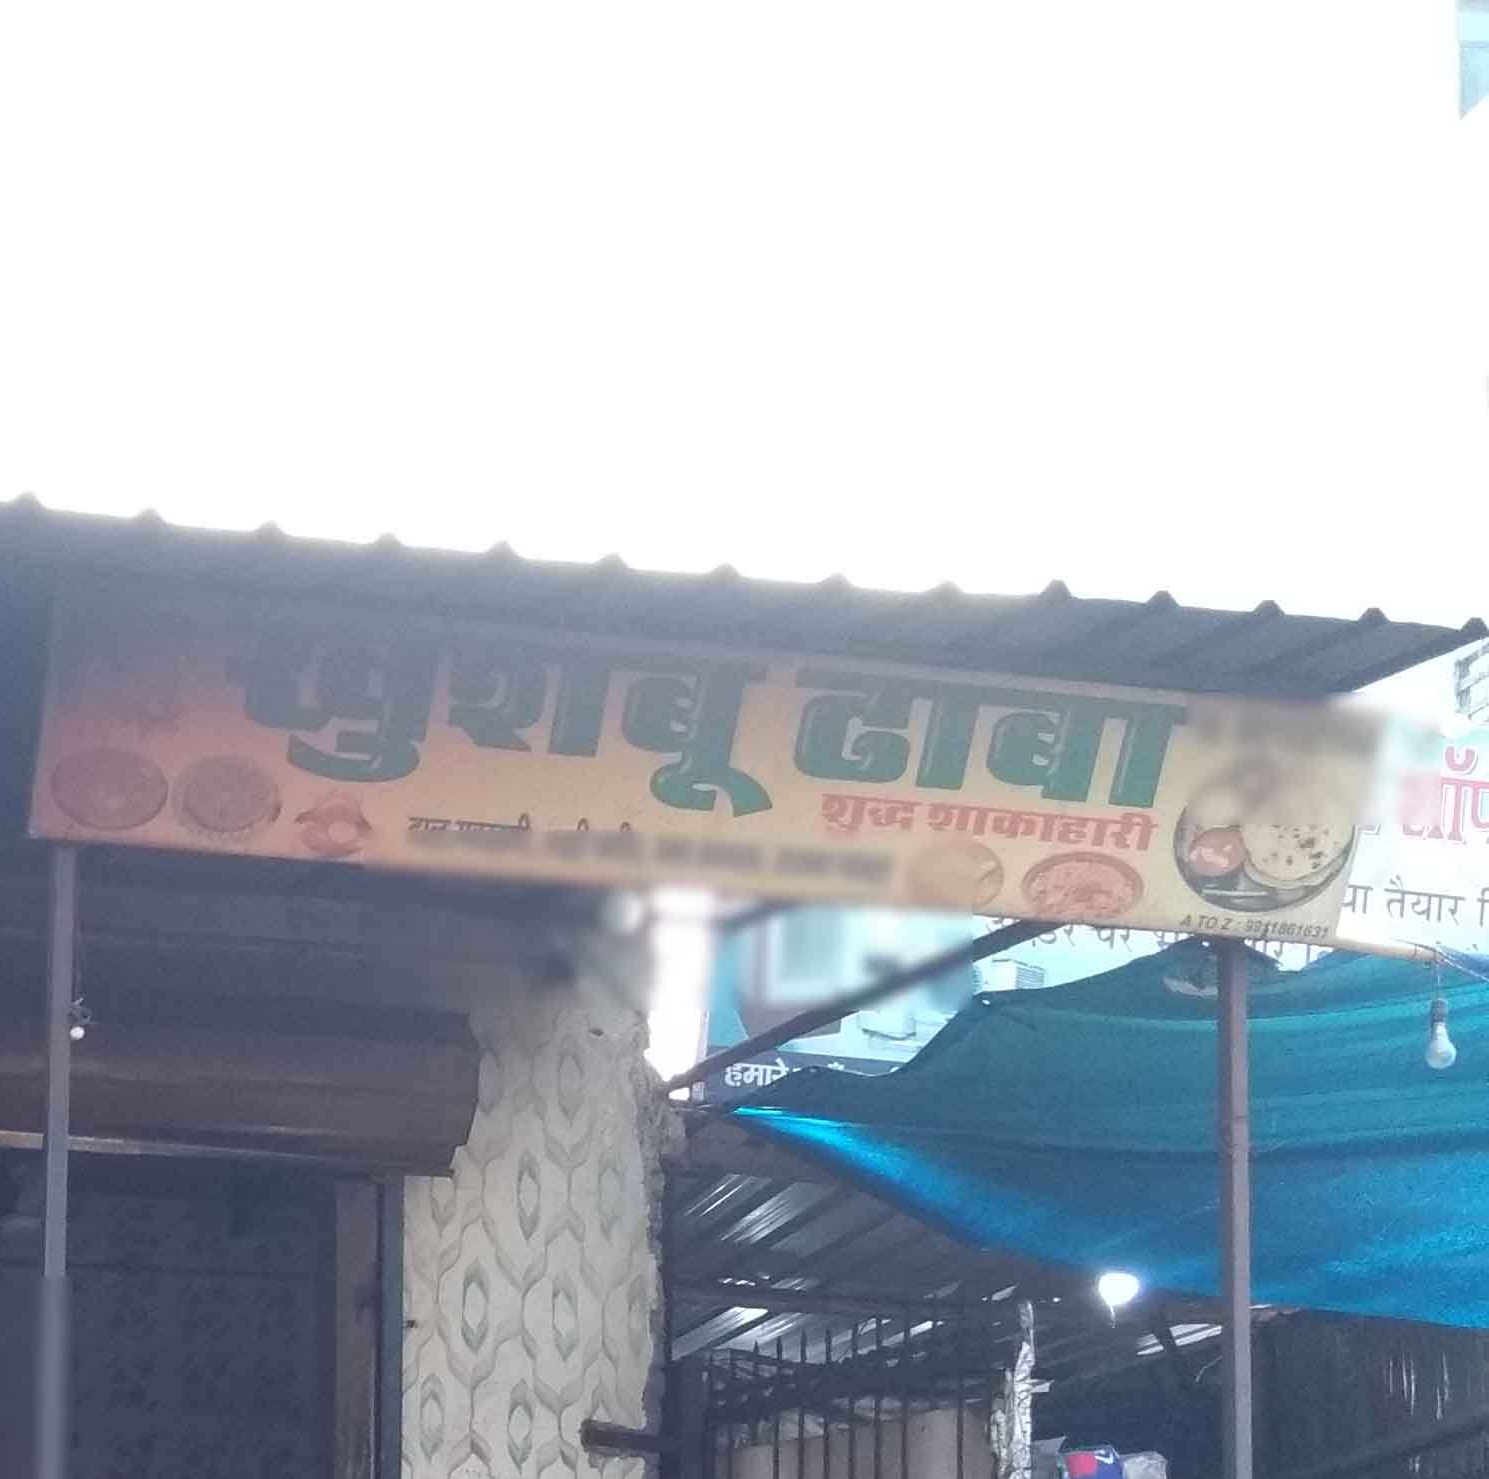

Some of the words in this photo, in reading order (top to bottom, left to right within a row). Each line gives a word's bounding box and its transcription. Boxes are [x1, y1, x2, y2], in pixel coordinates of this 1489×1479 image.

[794, 670, 1187, 808] ढाबा
[821, 793, 921, 839] शुद्ध
[925, 803, 1158, 850] शाकाहारी
[1179, 914, 1191, 927] A
[1197, 915, 1217, 930] TO
[1221, 918, 1233, 930] Z
[1383, 874, 1466, 925] तैयार
